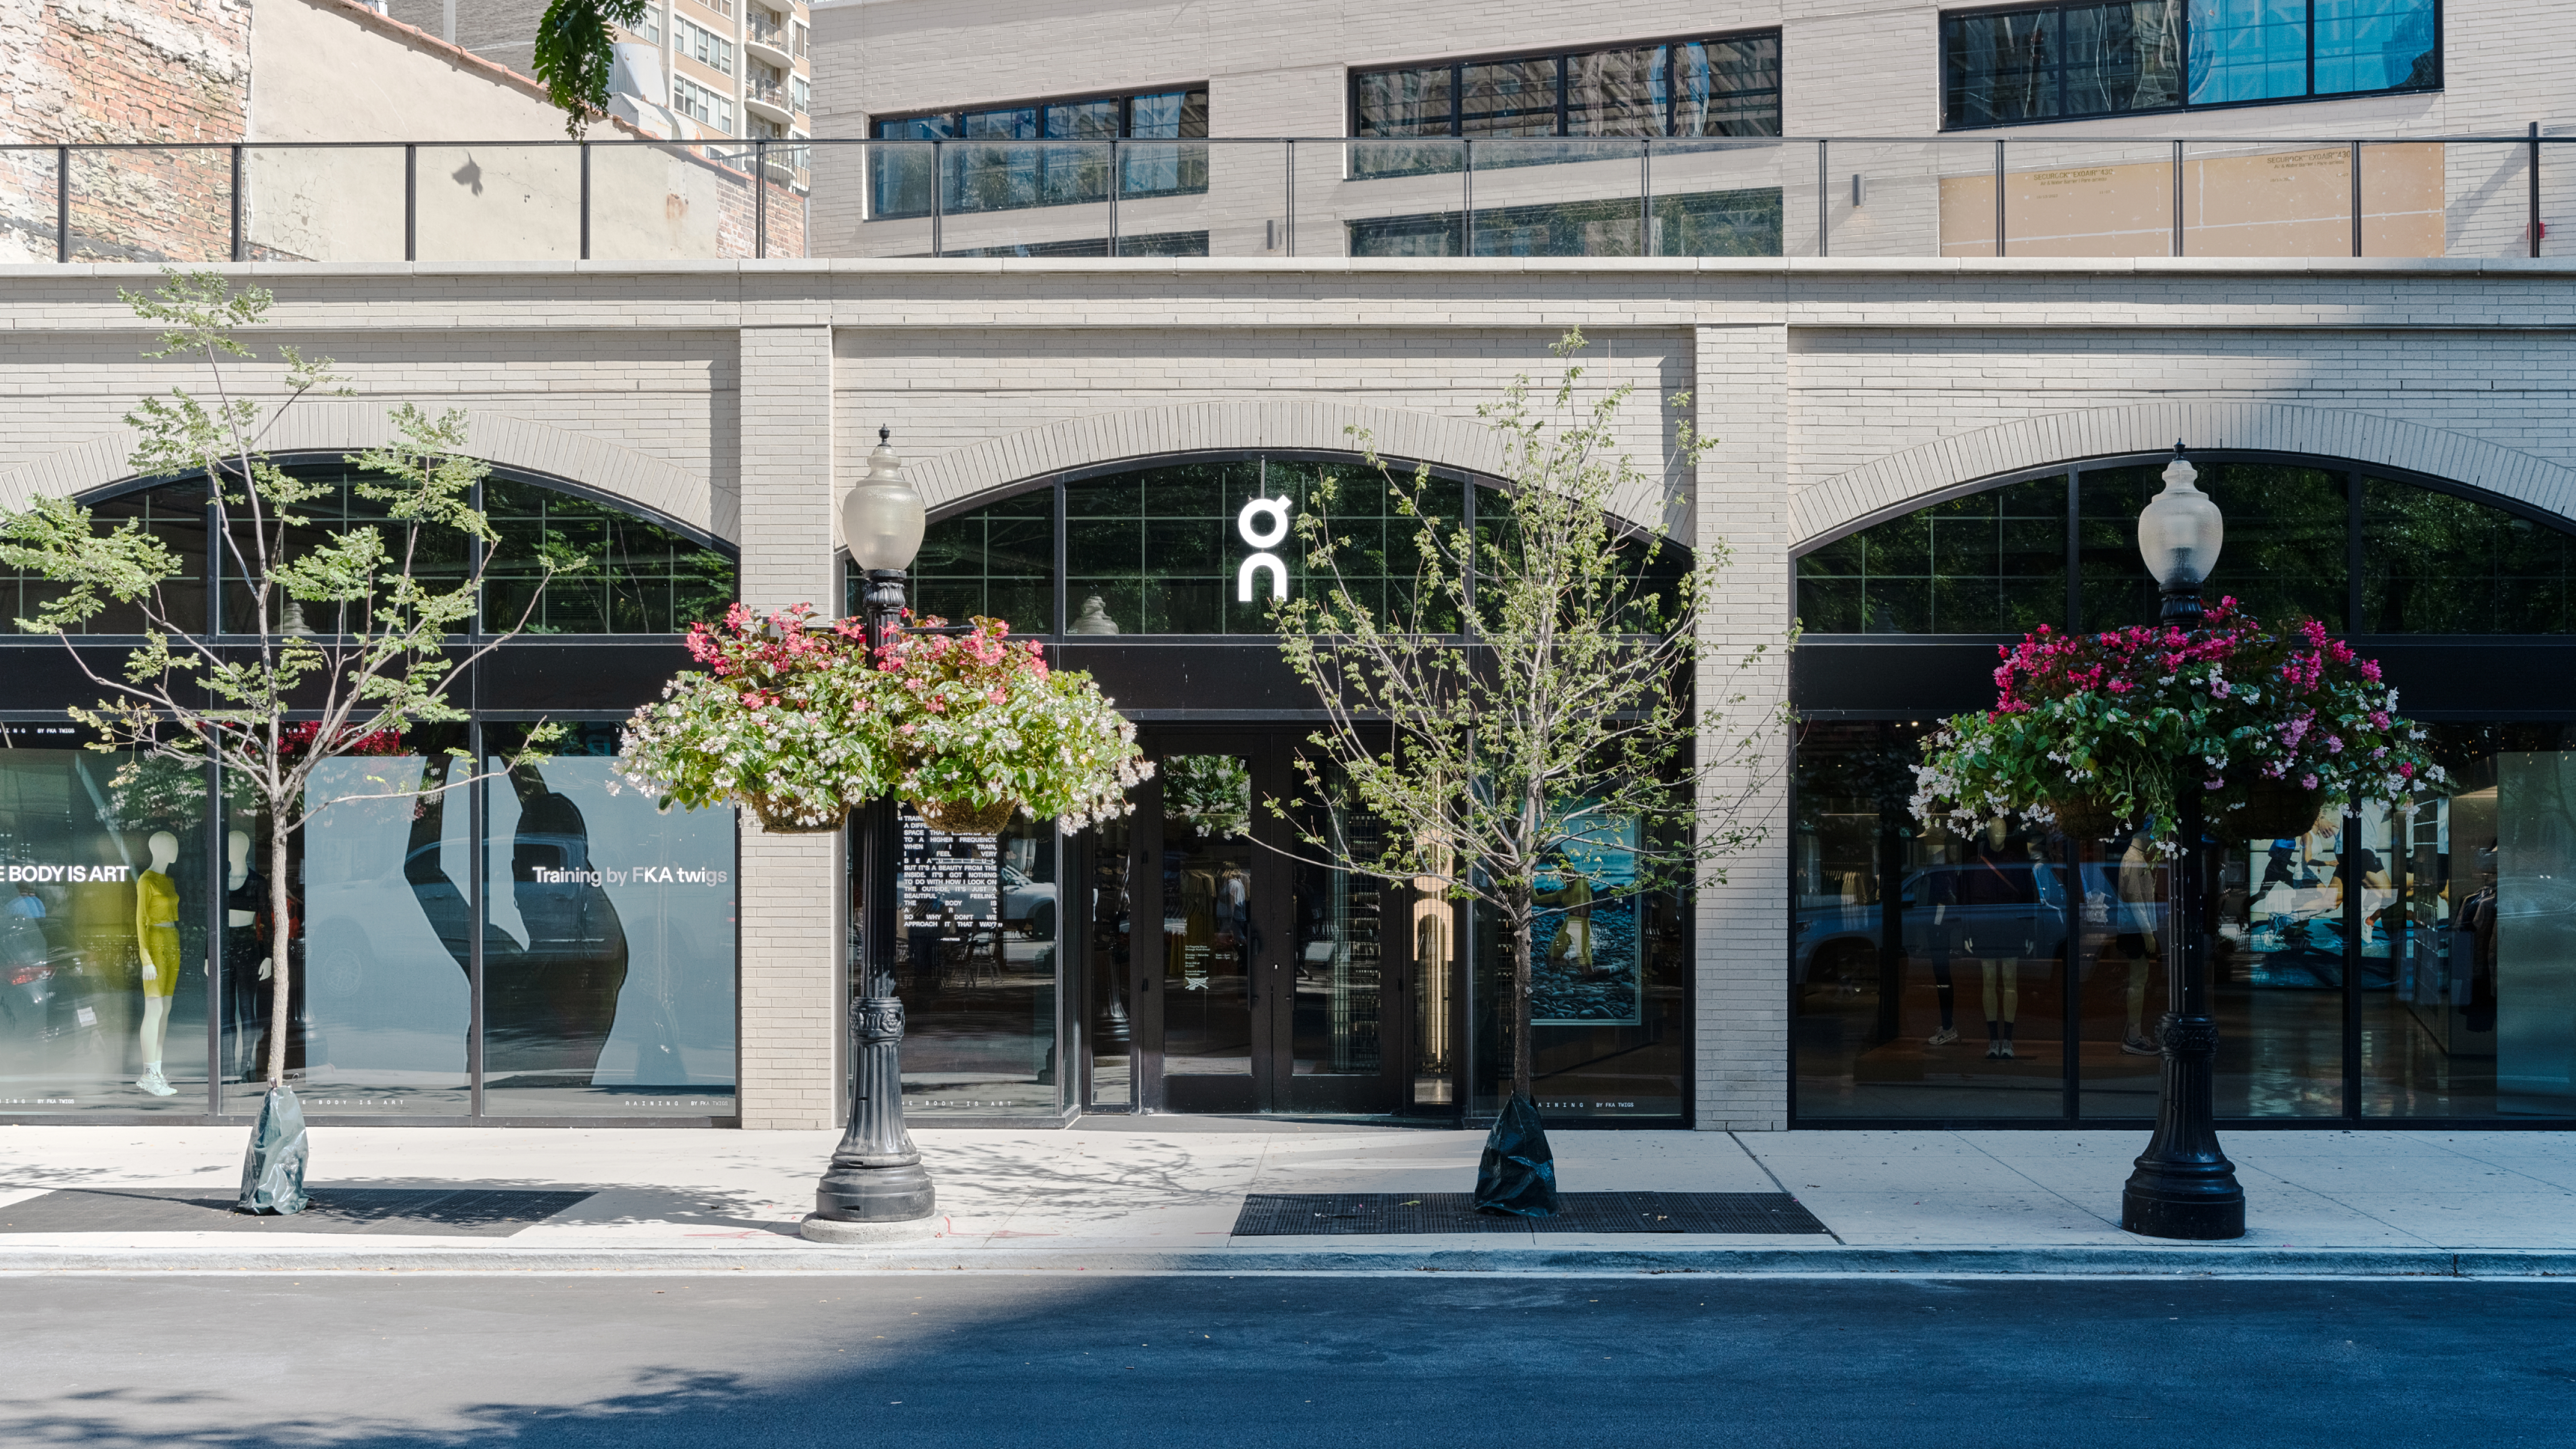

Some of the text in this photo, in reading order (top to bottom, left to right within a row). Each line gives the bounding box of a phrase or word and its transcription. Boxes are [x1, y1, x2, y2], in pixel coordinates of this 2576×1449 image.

[9, 865, 65, 882] BODY
[68, 865, 86, 882] IS
[89, 865, 129, 882] ART
[532, 867, 727, 887] Training by FKA twigs
